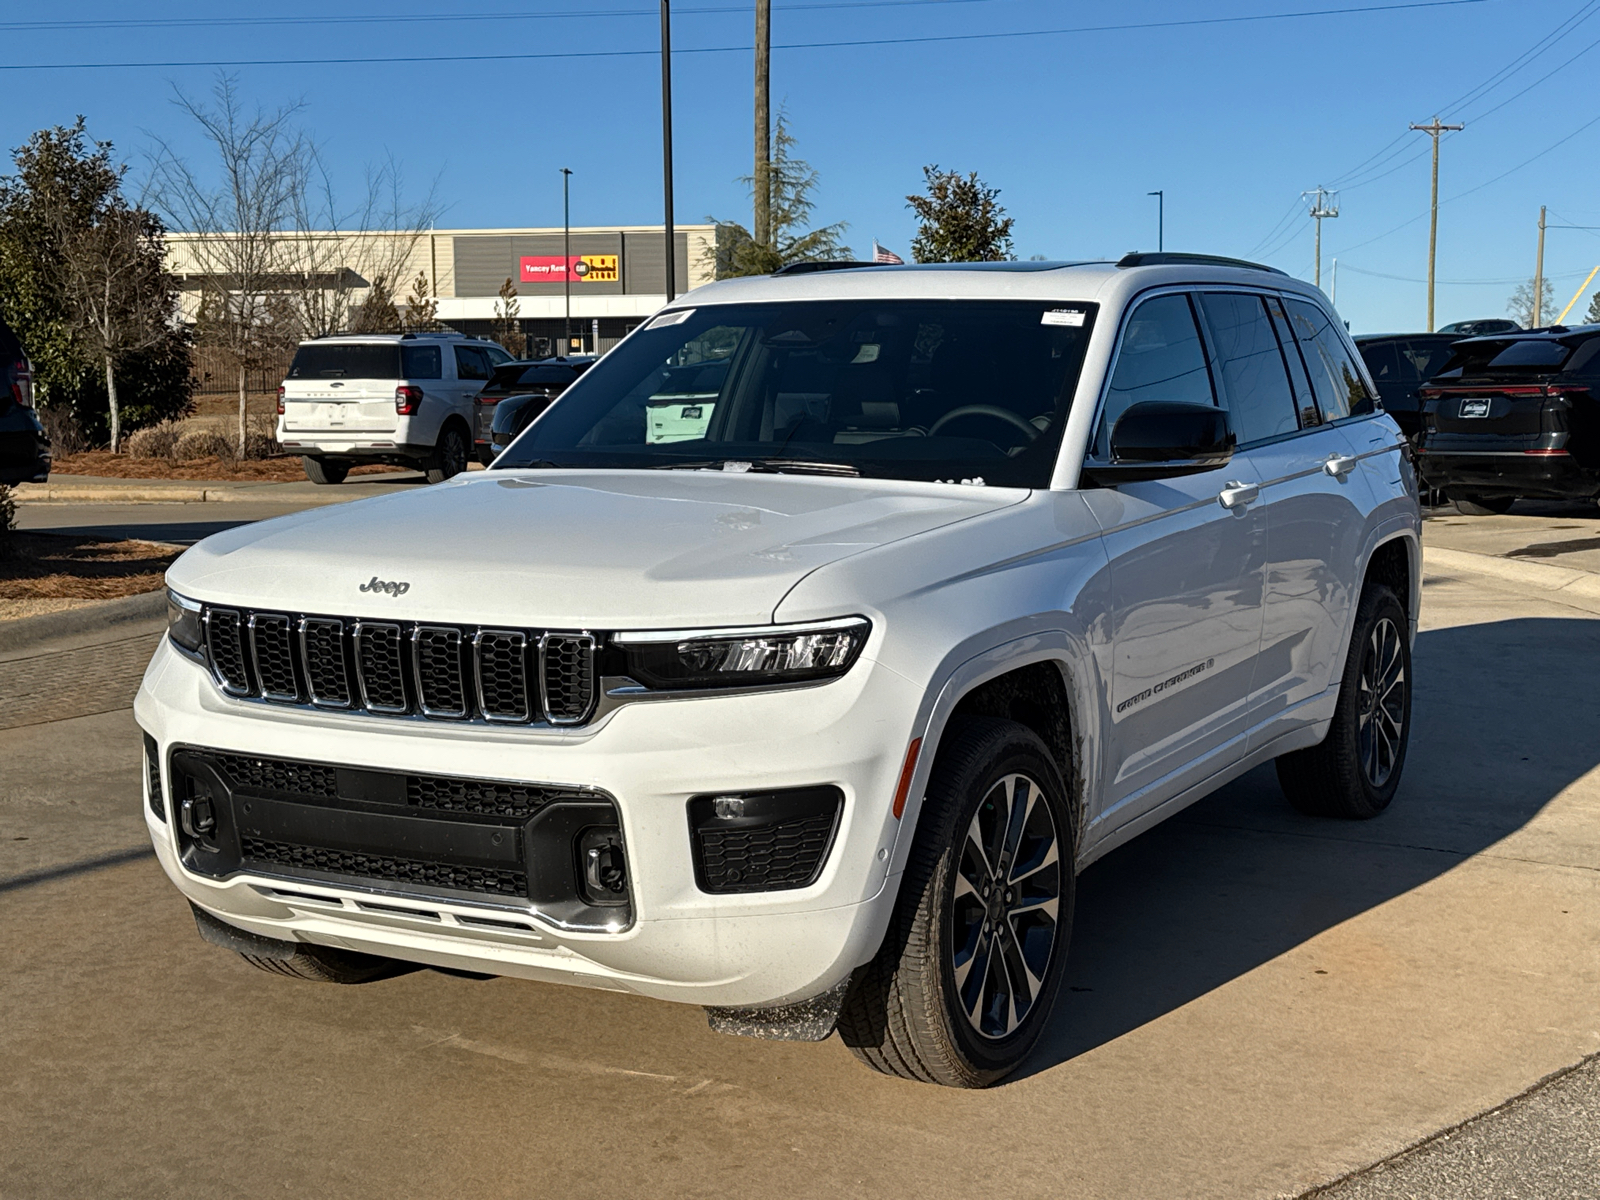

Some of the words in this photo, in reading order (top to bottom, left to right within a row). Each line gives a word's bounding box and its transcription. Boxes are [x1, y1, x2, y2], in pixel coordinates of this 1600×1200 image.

[525, 264, 550, 274] Yancey
[359, 576, 410, 598] Jeep
[1116, 688, 1152, 713] GRAND
[1153, 662, 1206, 694] CHEROKEE
